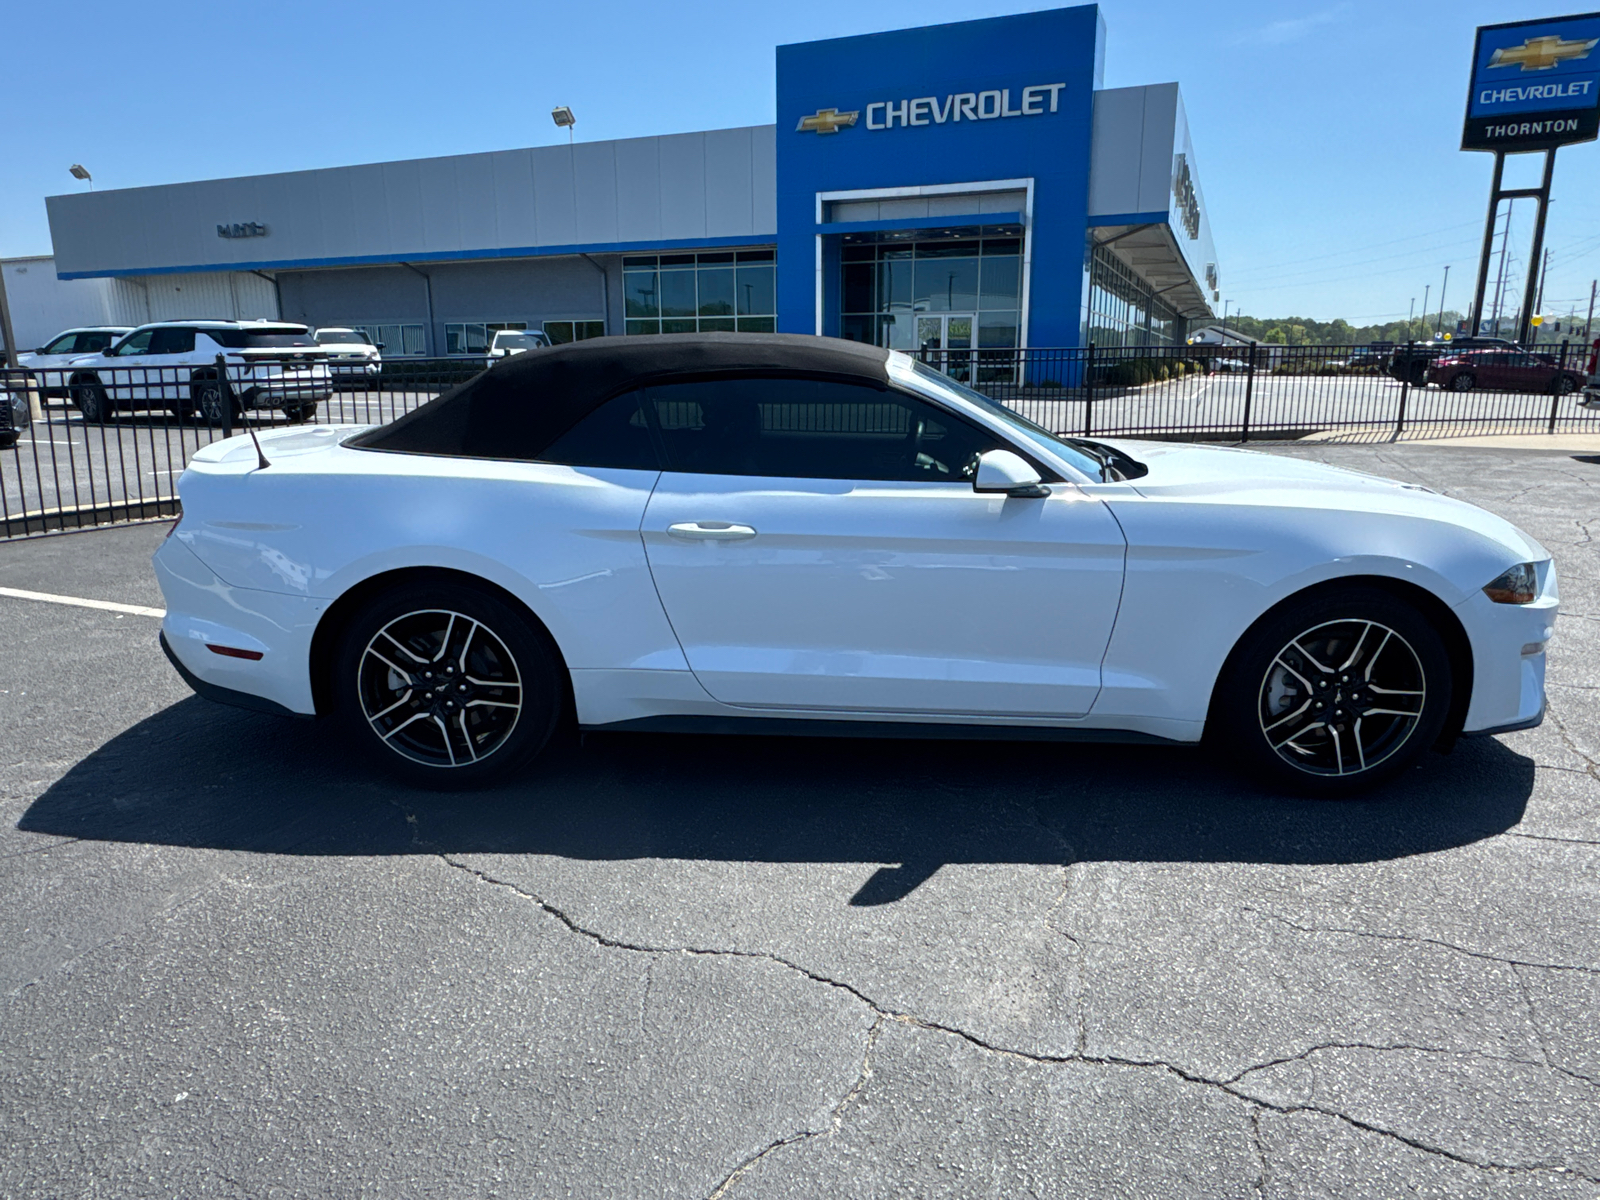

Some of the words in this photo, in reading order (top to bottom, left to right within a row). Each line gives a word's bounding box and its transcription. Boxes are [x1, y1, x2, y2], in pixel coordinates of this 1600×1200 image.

[1480, 80, 1593, 104] CHEVROLET
[865, 82, 1066, 130] CHEVROLET
[1485, 119, 1578, 138] THORNTON
